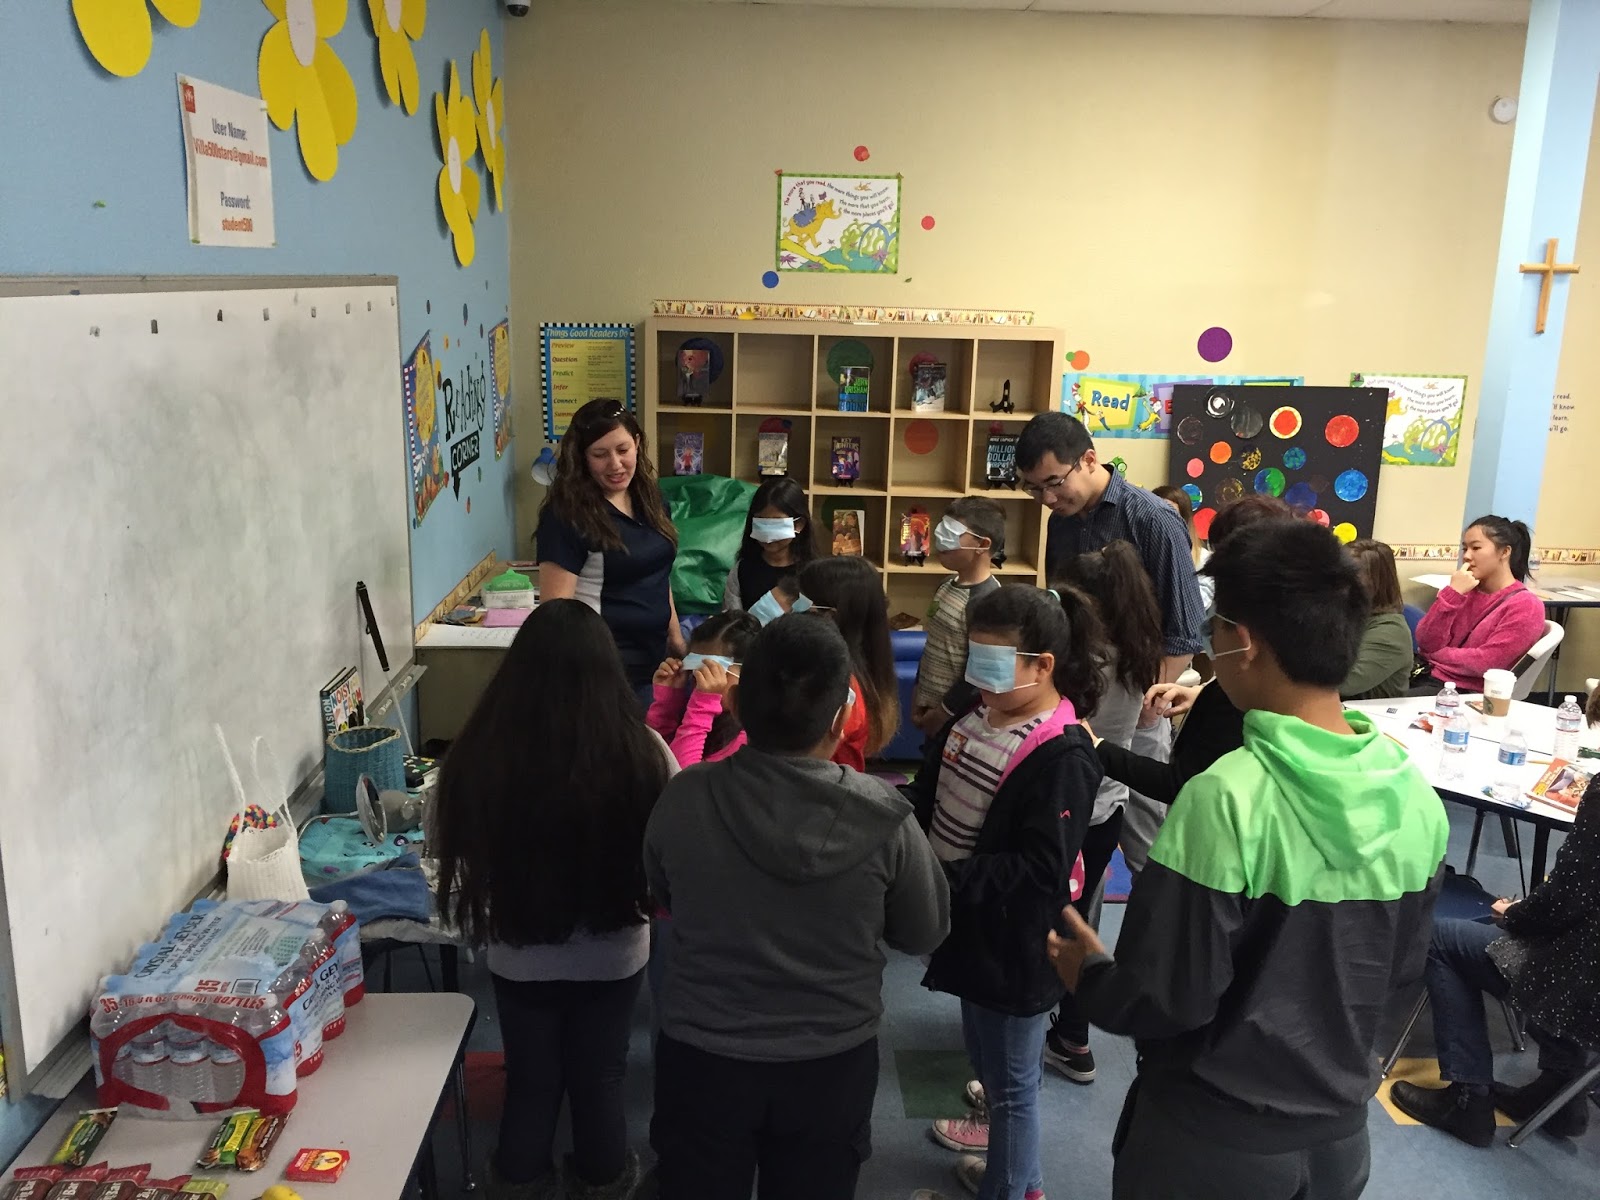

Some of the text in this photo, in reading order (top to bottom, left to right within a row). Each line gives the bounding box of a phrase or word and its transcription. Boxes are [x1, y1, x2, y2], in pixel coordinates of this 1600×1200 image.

[212, 118, 248, 141] User Name:
[220, 191, 251, 210] Password:
[546, 328, 629, 338] Things Good Readers Do
[1091, 390, 1130, 411] Read
[451, 435, 478, 471] CORNER
[988, 444, 1016, 453] MILLION
[331, 680, 351, 709] NOISY
[322, 698, 336, 729] NOISY
[134, 944, 176, 978] CRYSTAL
[100, 997, 119, 1014] 35
[213, 995, 266, 1010] BOTTLES
[20, 1180, 37, 1191] Bar
[62, 1182, 80, 1195] Bar
